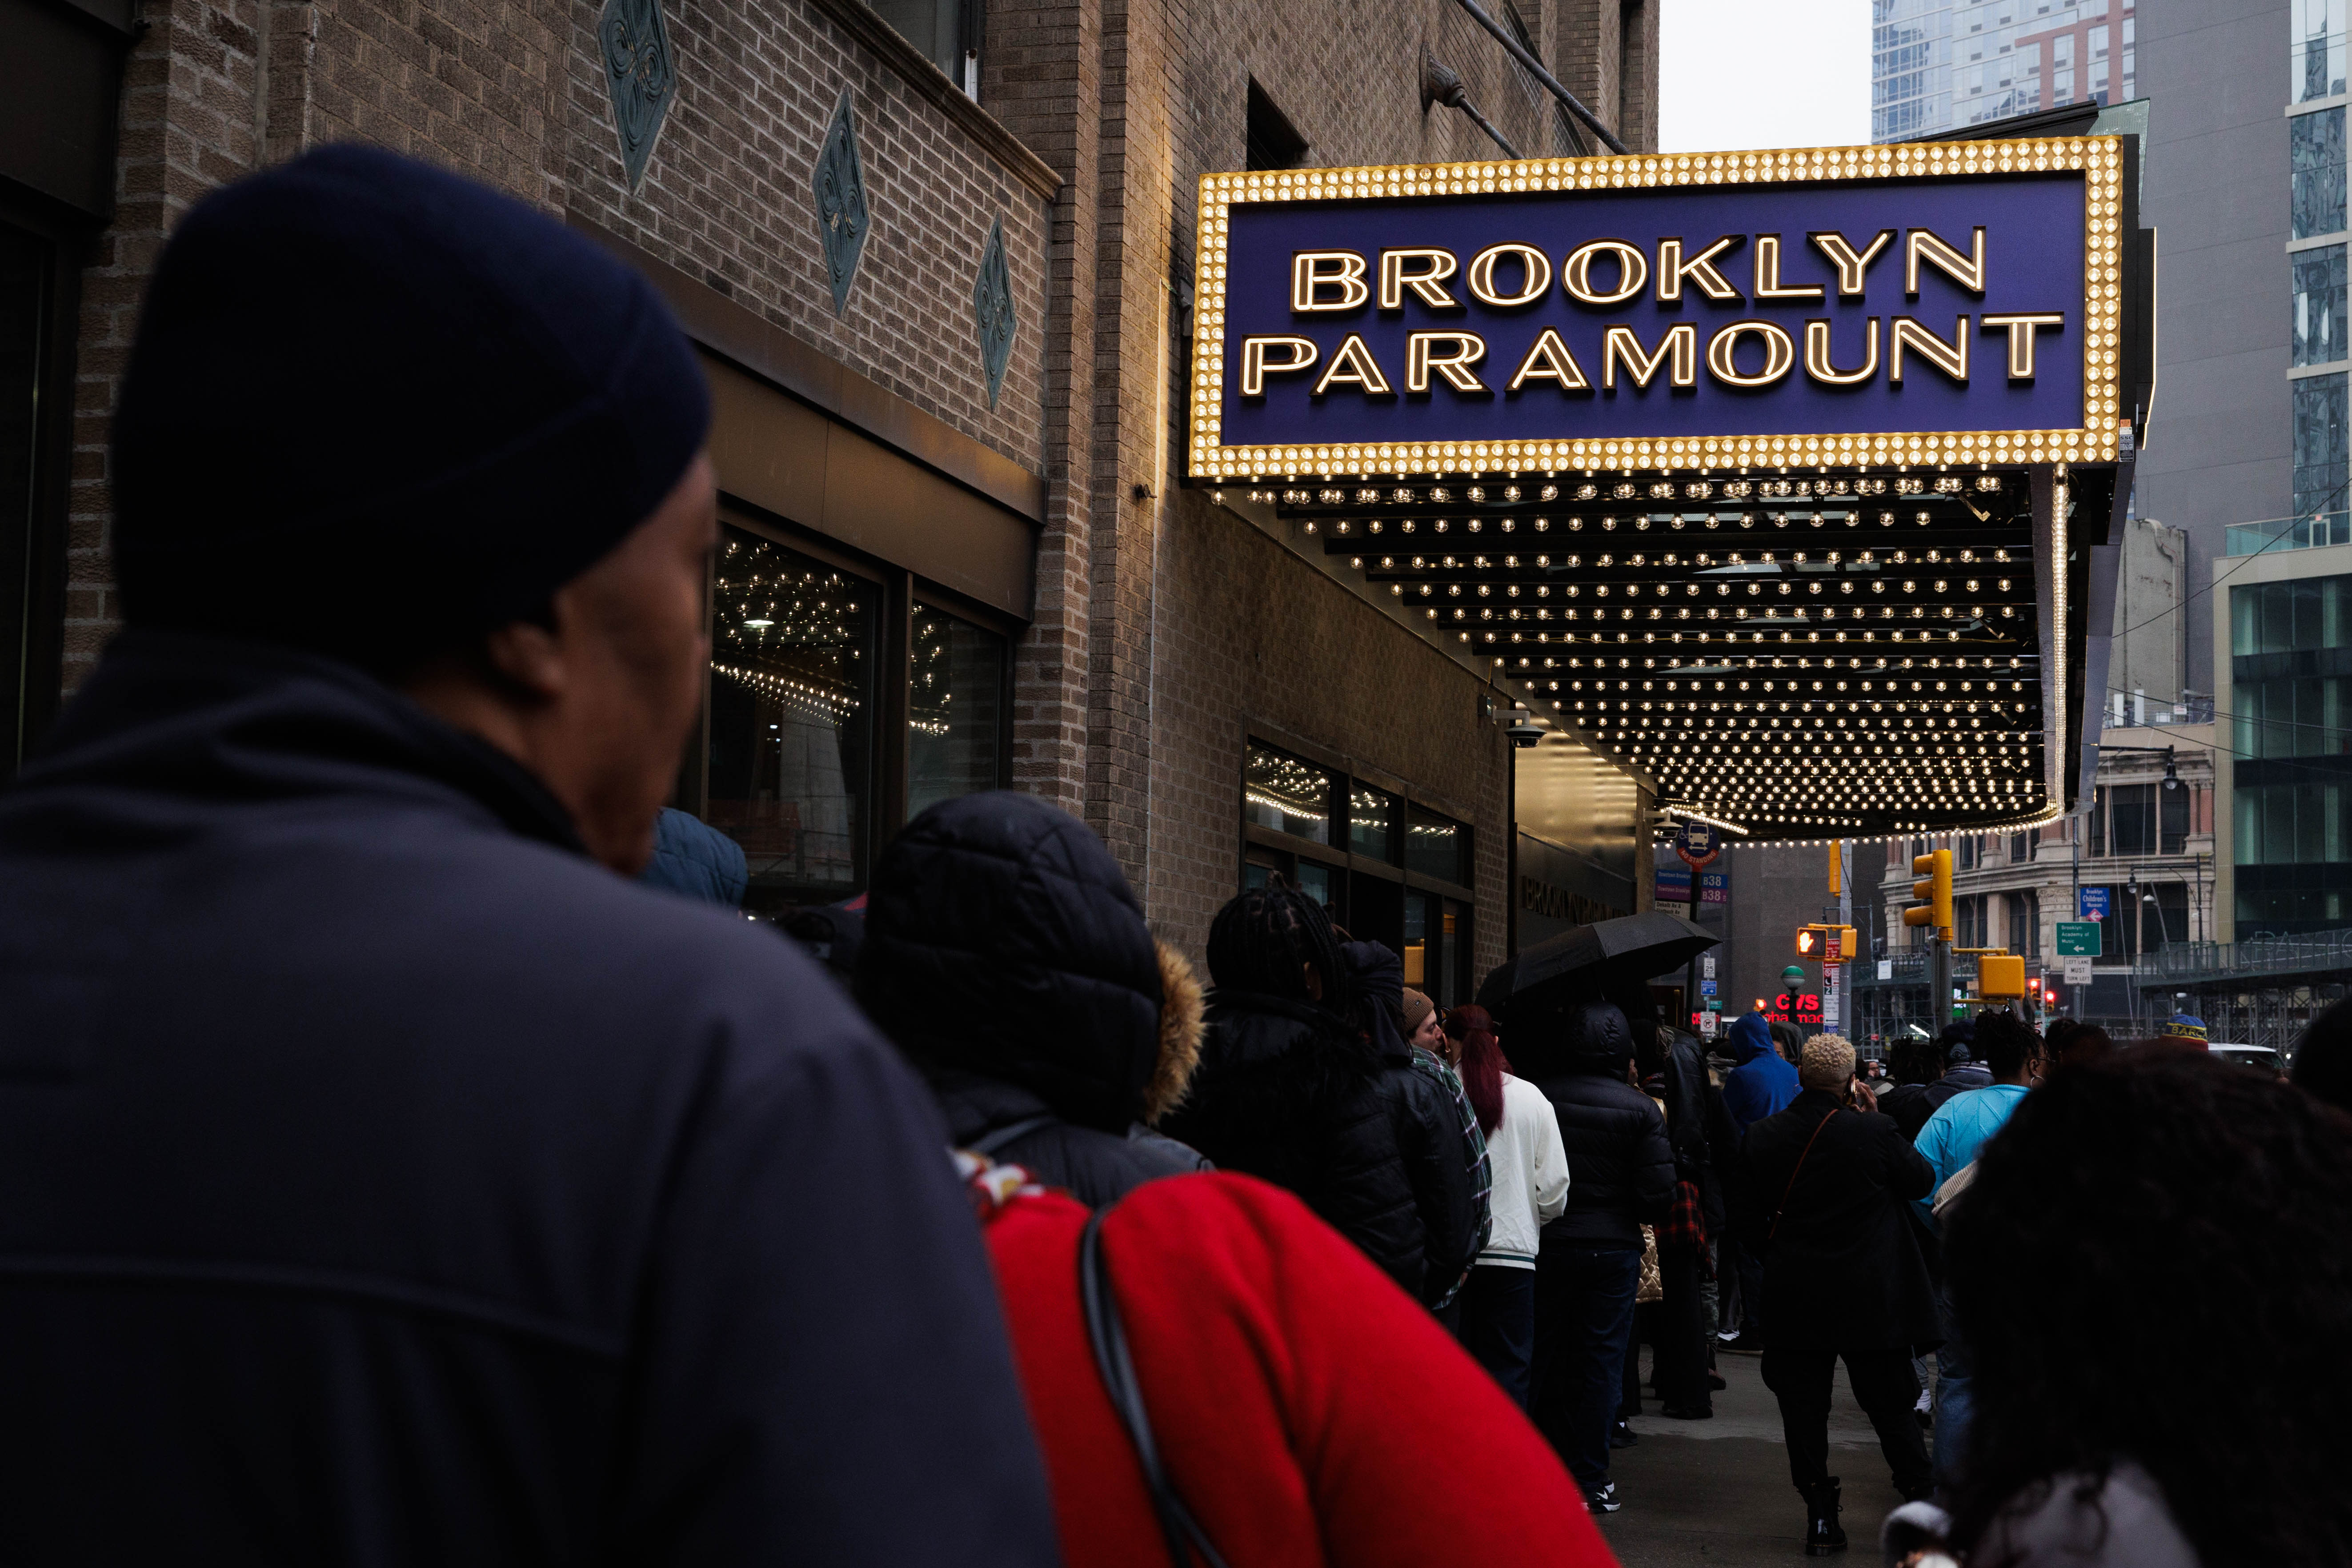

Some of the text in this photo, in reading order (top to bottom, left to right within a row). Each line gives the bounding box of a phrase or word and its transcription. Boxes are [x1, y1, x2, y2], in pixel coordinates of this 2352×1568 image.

[1290, 225, 1986, 313] BROOKLYN
[1239, 311, 2064, 397] PARAMOUNT
[1681, 849, 1716, 864] NO STANDING
[1703, 875, 1722, 886] B38
[1702, 890, 1721, 901] B38
[1775, 994, 1819, 1011] CVS
